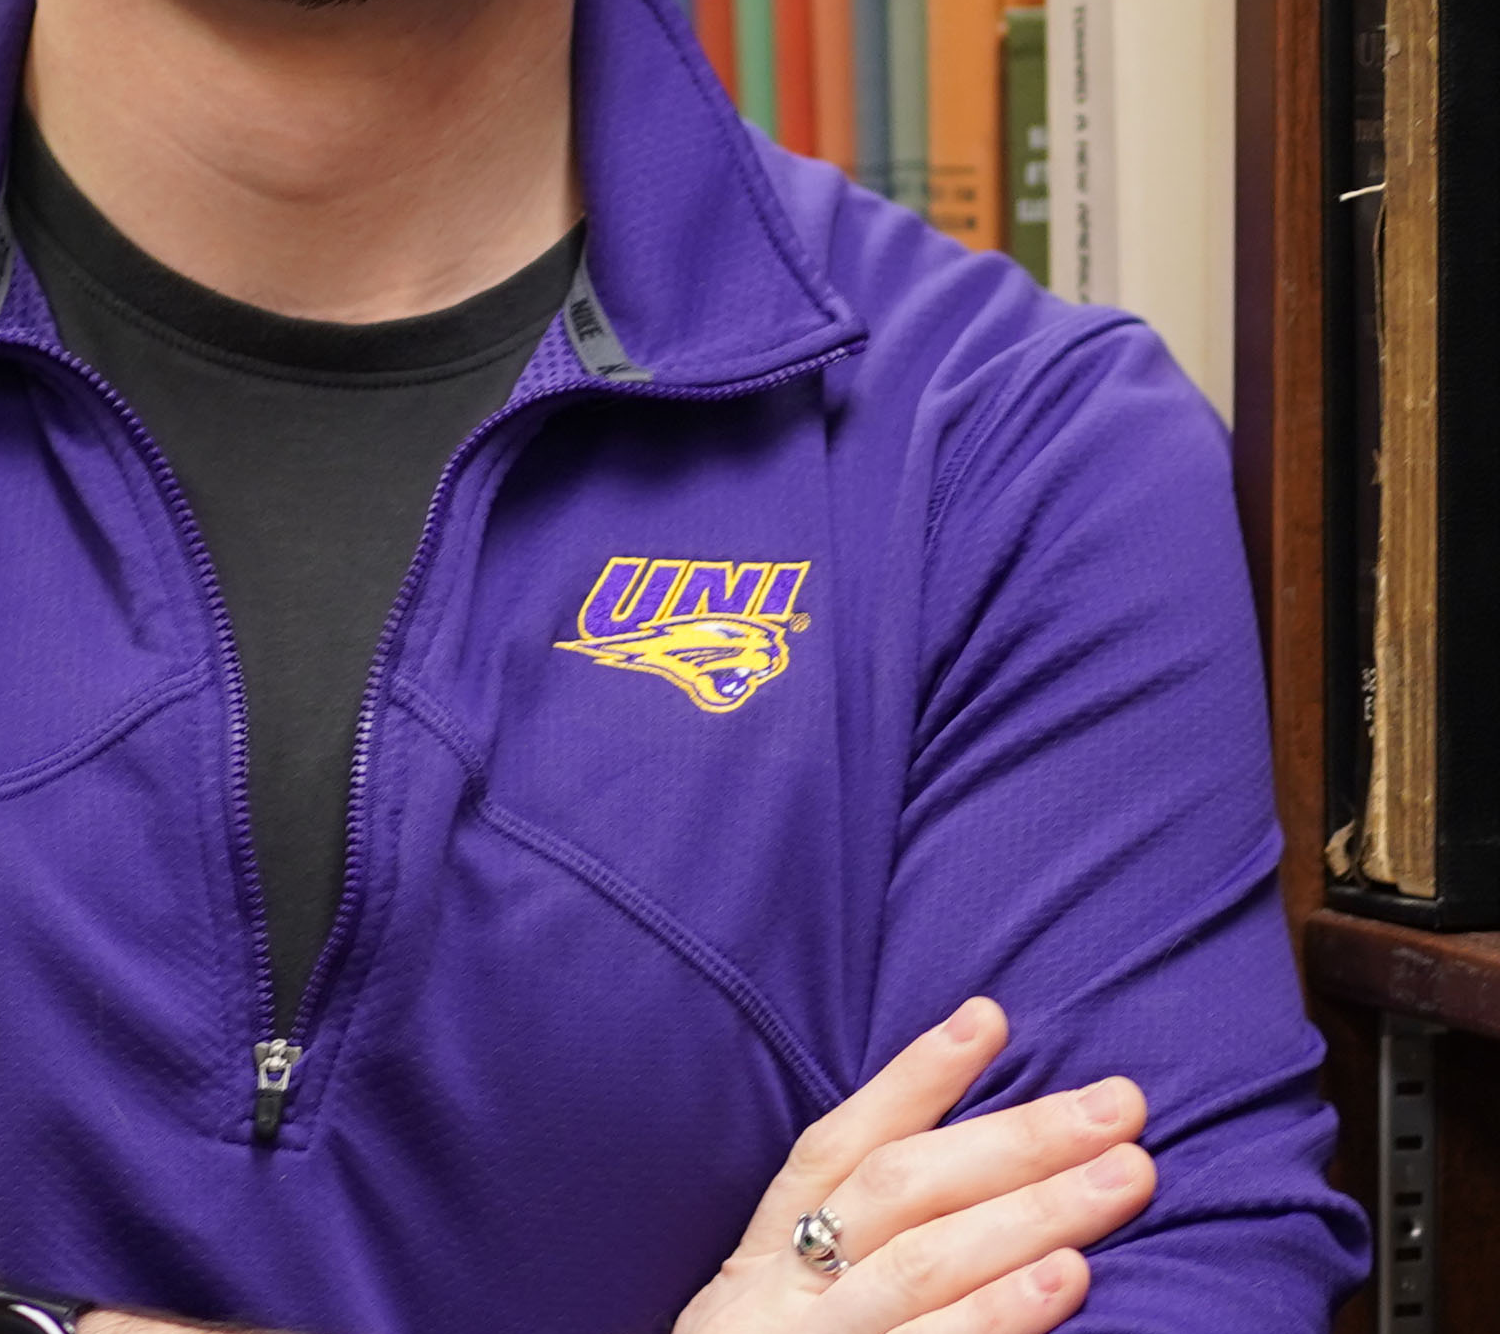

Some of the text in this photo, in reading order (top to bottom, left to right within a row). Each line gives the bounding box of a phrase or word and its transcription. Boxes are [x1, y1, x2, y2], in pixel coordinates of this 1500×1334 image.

[1075, 141, 1089, 194] NEW
[568, 296, 605, 344] NIKE
[577, 555, 811, 640] UNI
